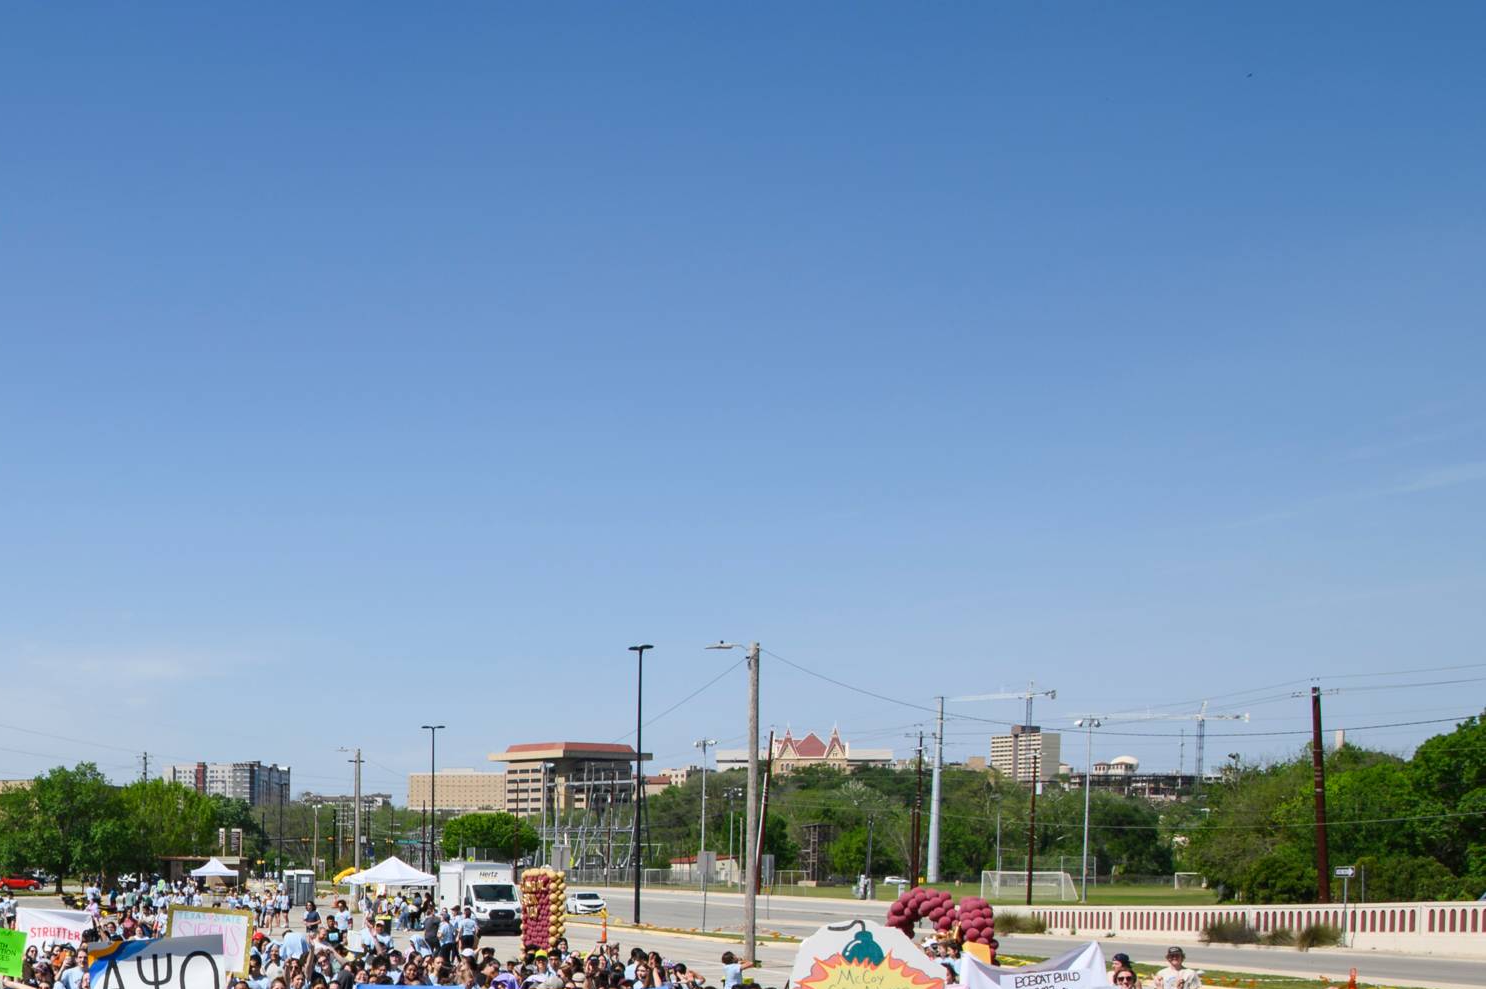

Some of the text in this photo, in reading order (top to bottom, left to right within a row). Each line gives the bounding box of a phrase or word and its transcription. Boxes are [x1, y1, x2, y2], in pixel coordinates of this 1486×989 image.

[837, 969, 884, 987] McCoy
[1015, 972, 1081, 988] BOBCAT BUILD
